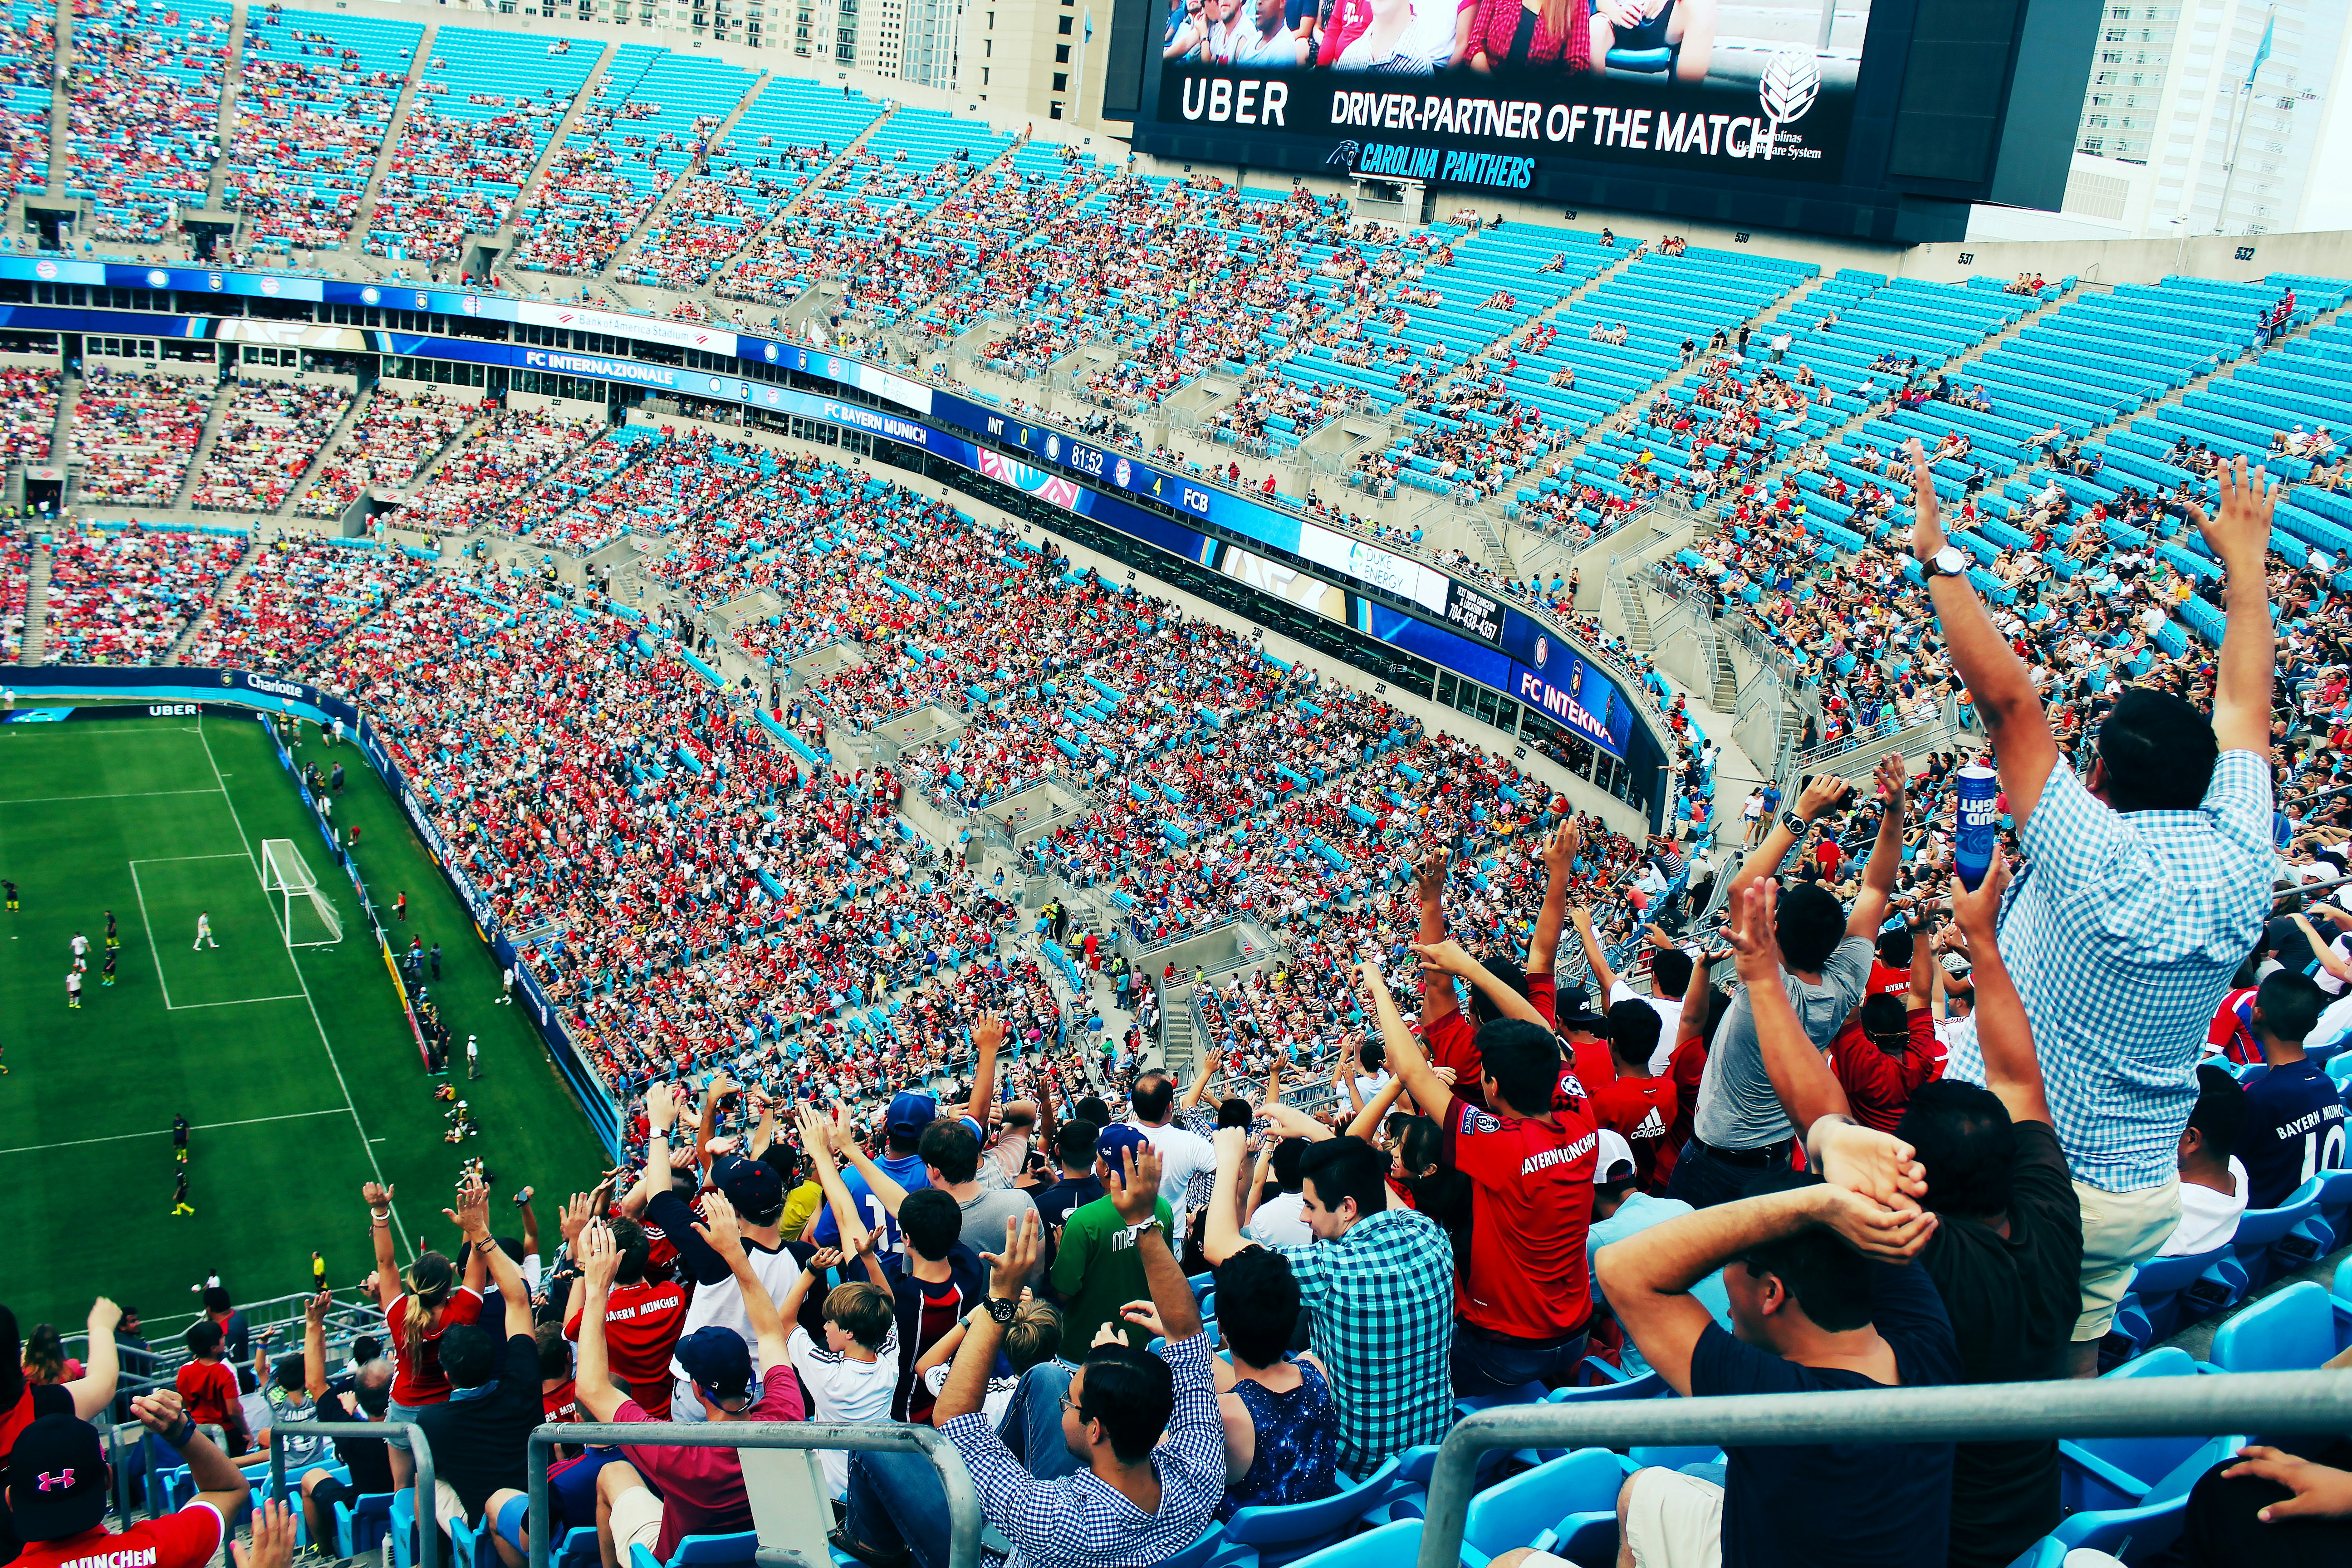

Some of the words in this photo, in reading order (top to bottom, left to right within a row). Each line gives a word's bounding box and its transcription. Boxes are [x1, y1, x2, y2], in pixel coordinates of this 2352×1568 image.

[1182, 77, 1289, 126] UBER
[1331, 90, 1542, 140] DRIVER-PARTNER
[1546, 103, 1588, 142] OF
[1592, 106, 1652, 149] THE
[1655, 111, 1779, 160] MATCH
[1759, 129, 1803, 143] Colinas
[1788, 145, 1822, 161] System
[1361, 142, 1439, 179] CAROLINA
[1444, 150, 1535, 189] PANTHERS
[1735, 232, 1750, 243] 530
[1958, 253, 1974, 265] 531
[2235, 247, 2255, 261] 532
[579, 314, 602, 326] Bank
[604, 318, 612, 328] of
[613, 319, 651, 334] America
[652, 325, 690, 340] Stadium
[526, 351, 546, 367] FC
[548, 355, 673, 385] INTERNAZIONALE
[824, 402, 840, 416] FC
[841, 409, 883, 429] BAYERN
[884, 418, 927, 445] MUNICH
[987, 416, 1004, 436] INT
[1020, 427, 1028, 446] 0
[1071, 445, 1103, 475] 81:52
[1153, 477, 1162, 497] 4
[1184, 487, 1209, 513] FCB
[1366, 547, 1392, 570] DUKE
[1364, 565, 1403, 591] ENERGY
[1457, 585, 1467, 598] TEXT
[1466, 590, 1477, 603] YOUR
[1476, 596, 1497, 613] CONCERN
[1463, 599, 1483, 616] LOCATION
[1481, 608, 1488, 619] TO
[1252, 627, 1263, 638] 230
[1448, 602, 1498, 640] 704-438-4357
[247, 673, 303, 698] Charlotte
[1374, 682, 1387, 695] 231
[1521, 671, 1543, 702] FC
[149, 704, 196, 716] UBER
[1514, 745, 1526, 760] 232
[1960, 798, 1996, 813] GHT
[442, 848, 476, 912] CAMPIONS
[1885, 982, 1904, 993] BAYRN
[1631, 1124, 1666, 1139] adidas
[2276, 1110, 2320, 1140] BAYERN
